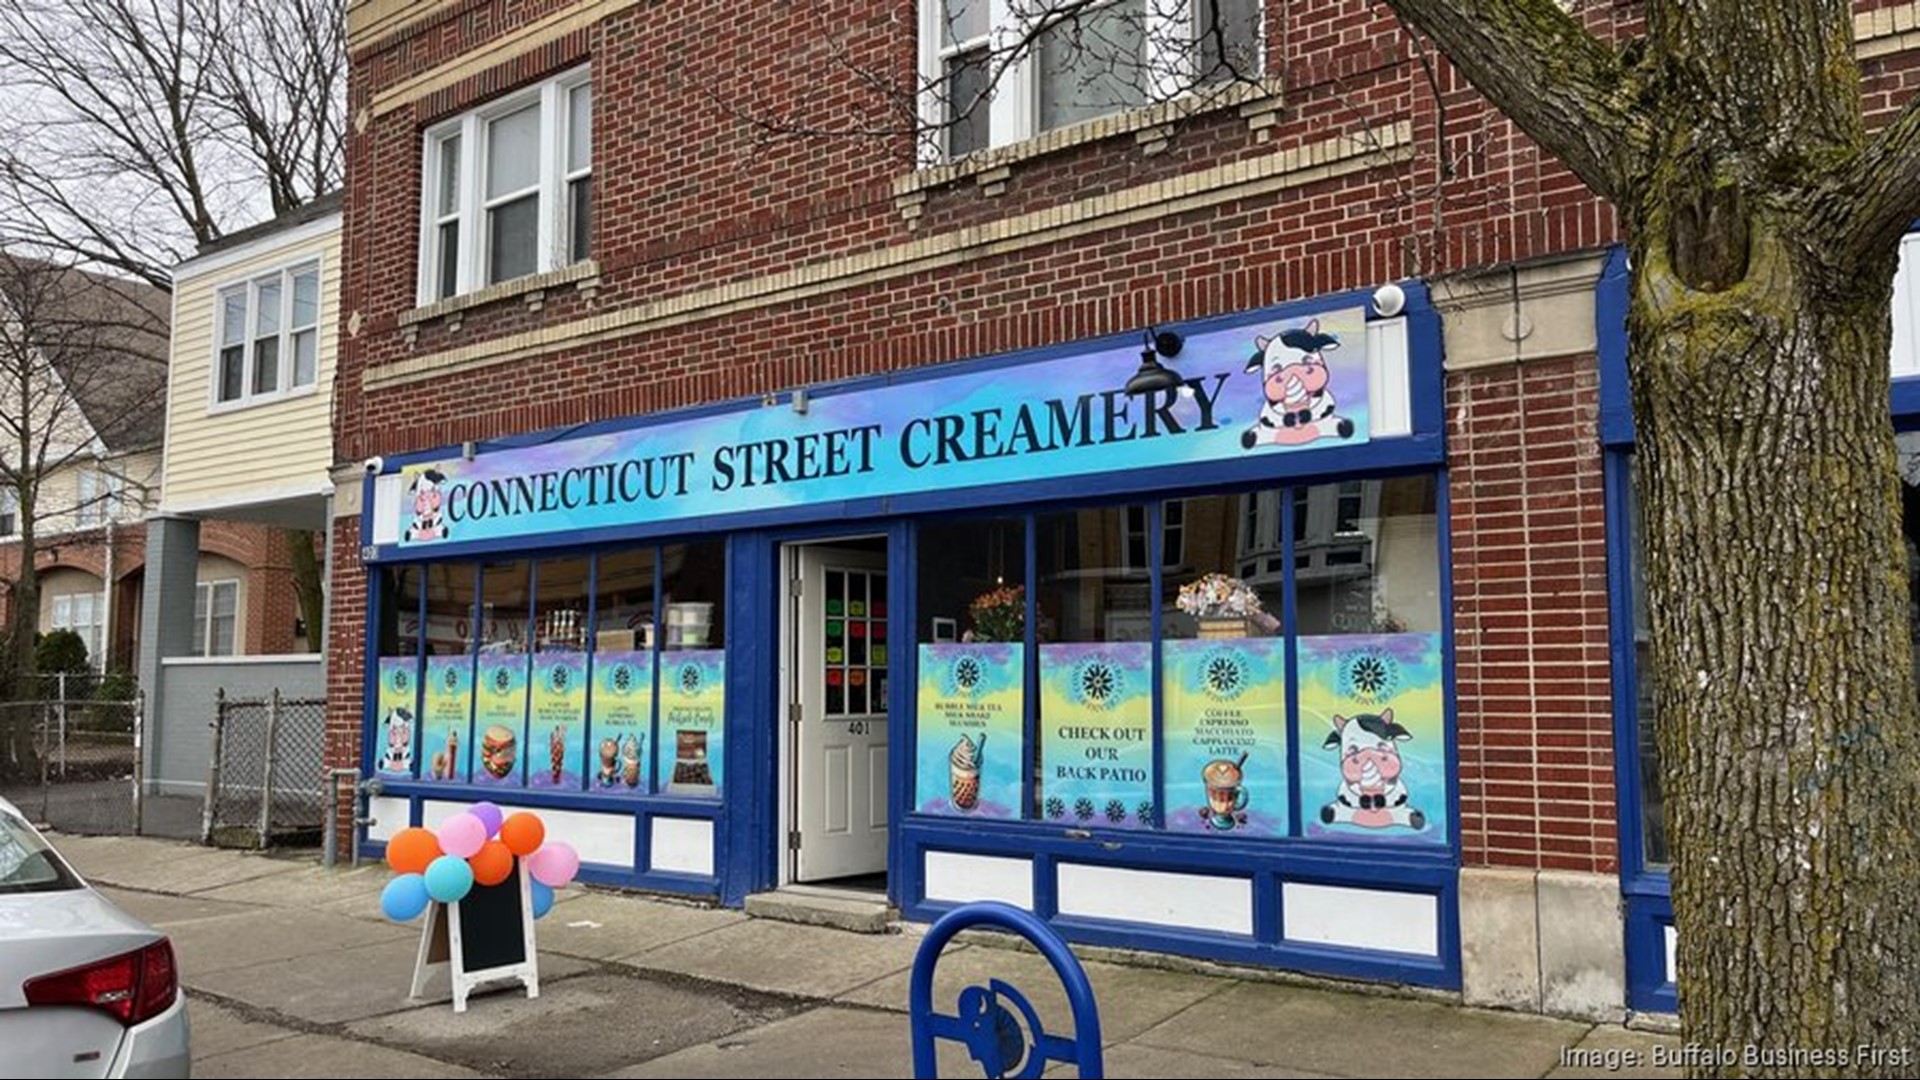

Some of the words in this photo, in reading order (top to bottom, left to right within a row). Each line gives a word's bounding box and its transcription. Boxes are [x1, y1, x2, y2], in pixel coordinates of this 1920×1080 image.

[447, 452, 694, 523] CONNECTICUT
[712, 424, 881, 491] STREET
[900, 373, 1230, 468] CREAMERY
[848, 721, 870, 735] 401
[1058, 725, 1110, 740] CHECK
[1113, 727, 1146, 741] OUT
[1085, 747, 1119, 761] OUR
[1209, 746, 1239, 755] LATTE
[1056, 765, 1098, 780] BACK
[1100, 767, 1146, 782] PATIO
